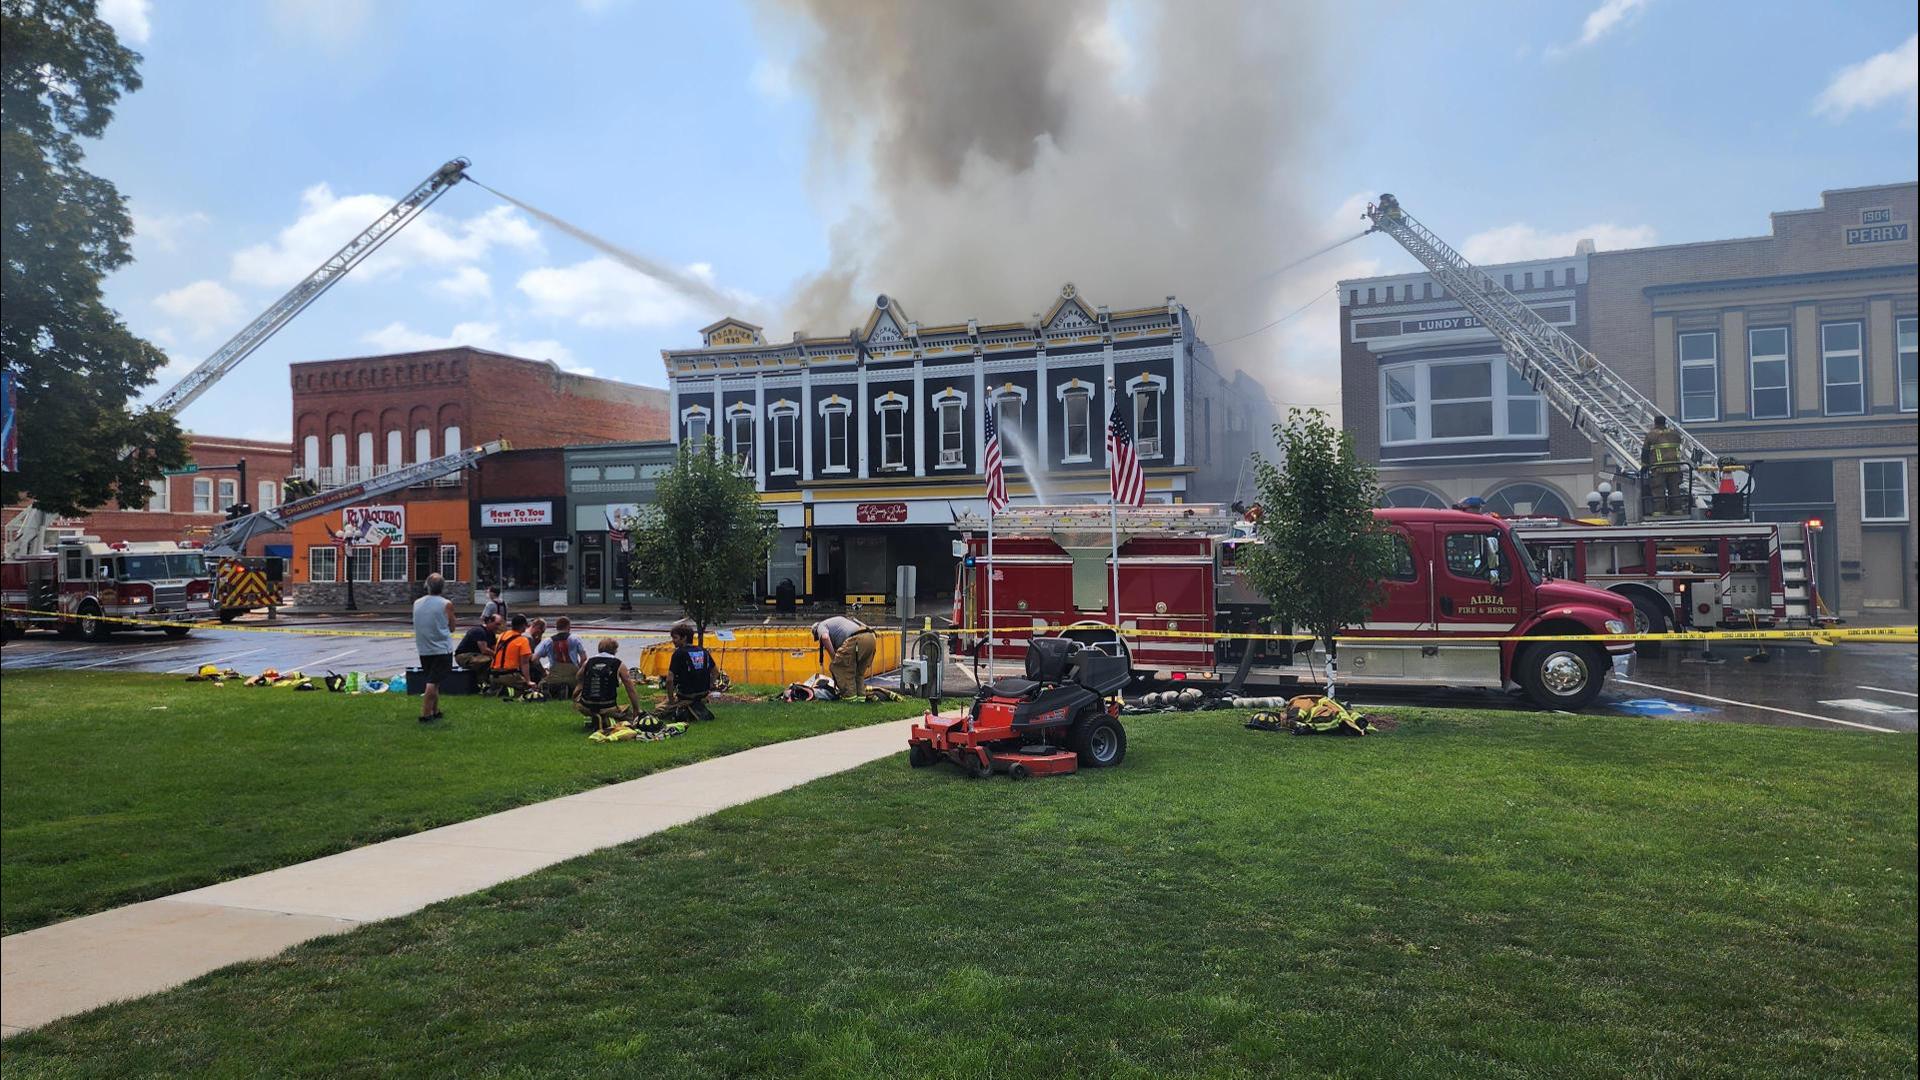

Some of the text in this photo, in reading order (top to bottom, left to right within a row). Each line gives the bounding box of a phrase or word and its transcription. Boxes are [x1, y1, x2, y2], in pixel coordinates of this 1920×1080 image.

[1849, 226, 1904, 242] PERRY
[1419, 320, 1459, 330] LUNDY
[490, 508, 545, 518] New To You
[1471, 596, 1503, 604] ALBIA
[1458, 606, 1476, 614] FIRE
[1487, 606, 1518, 614] RESCUE
